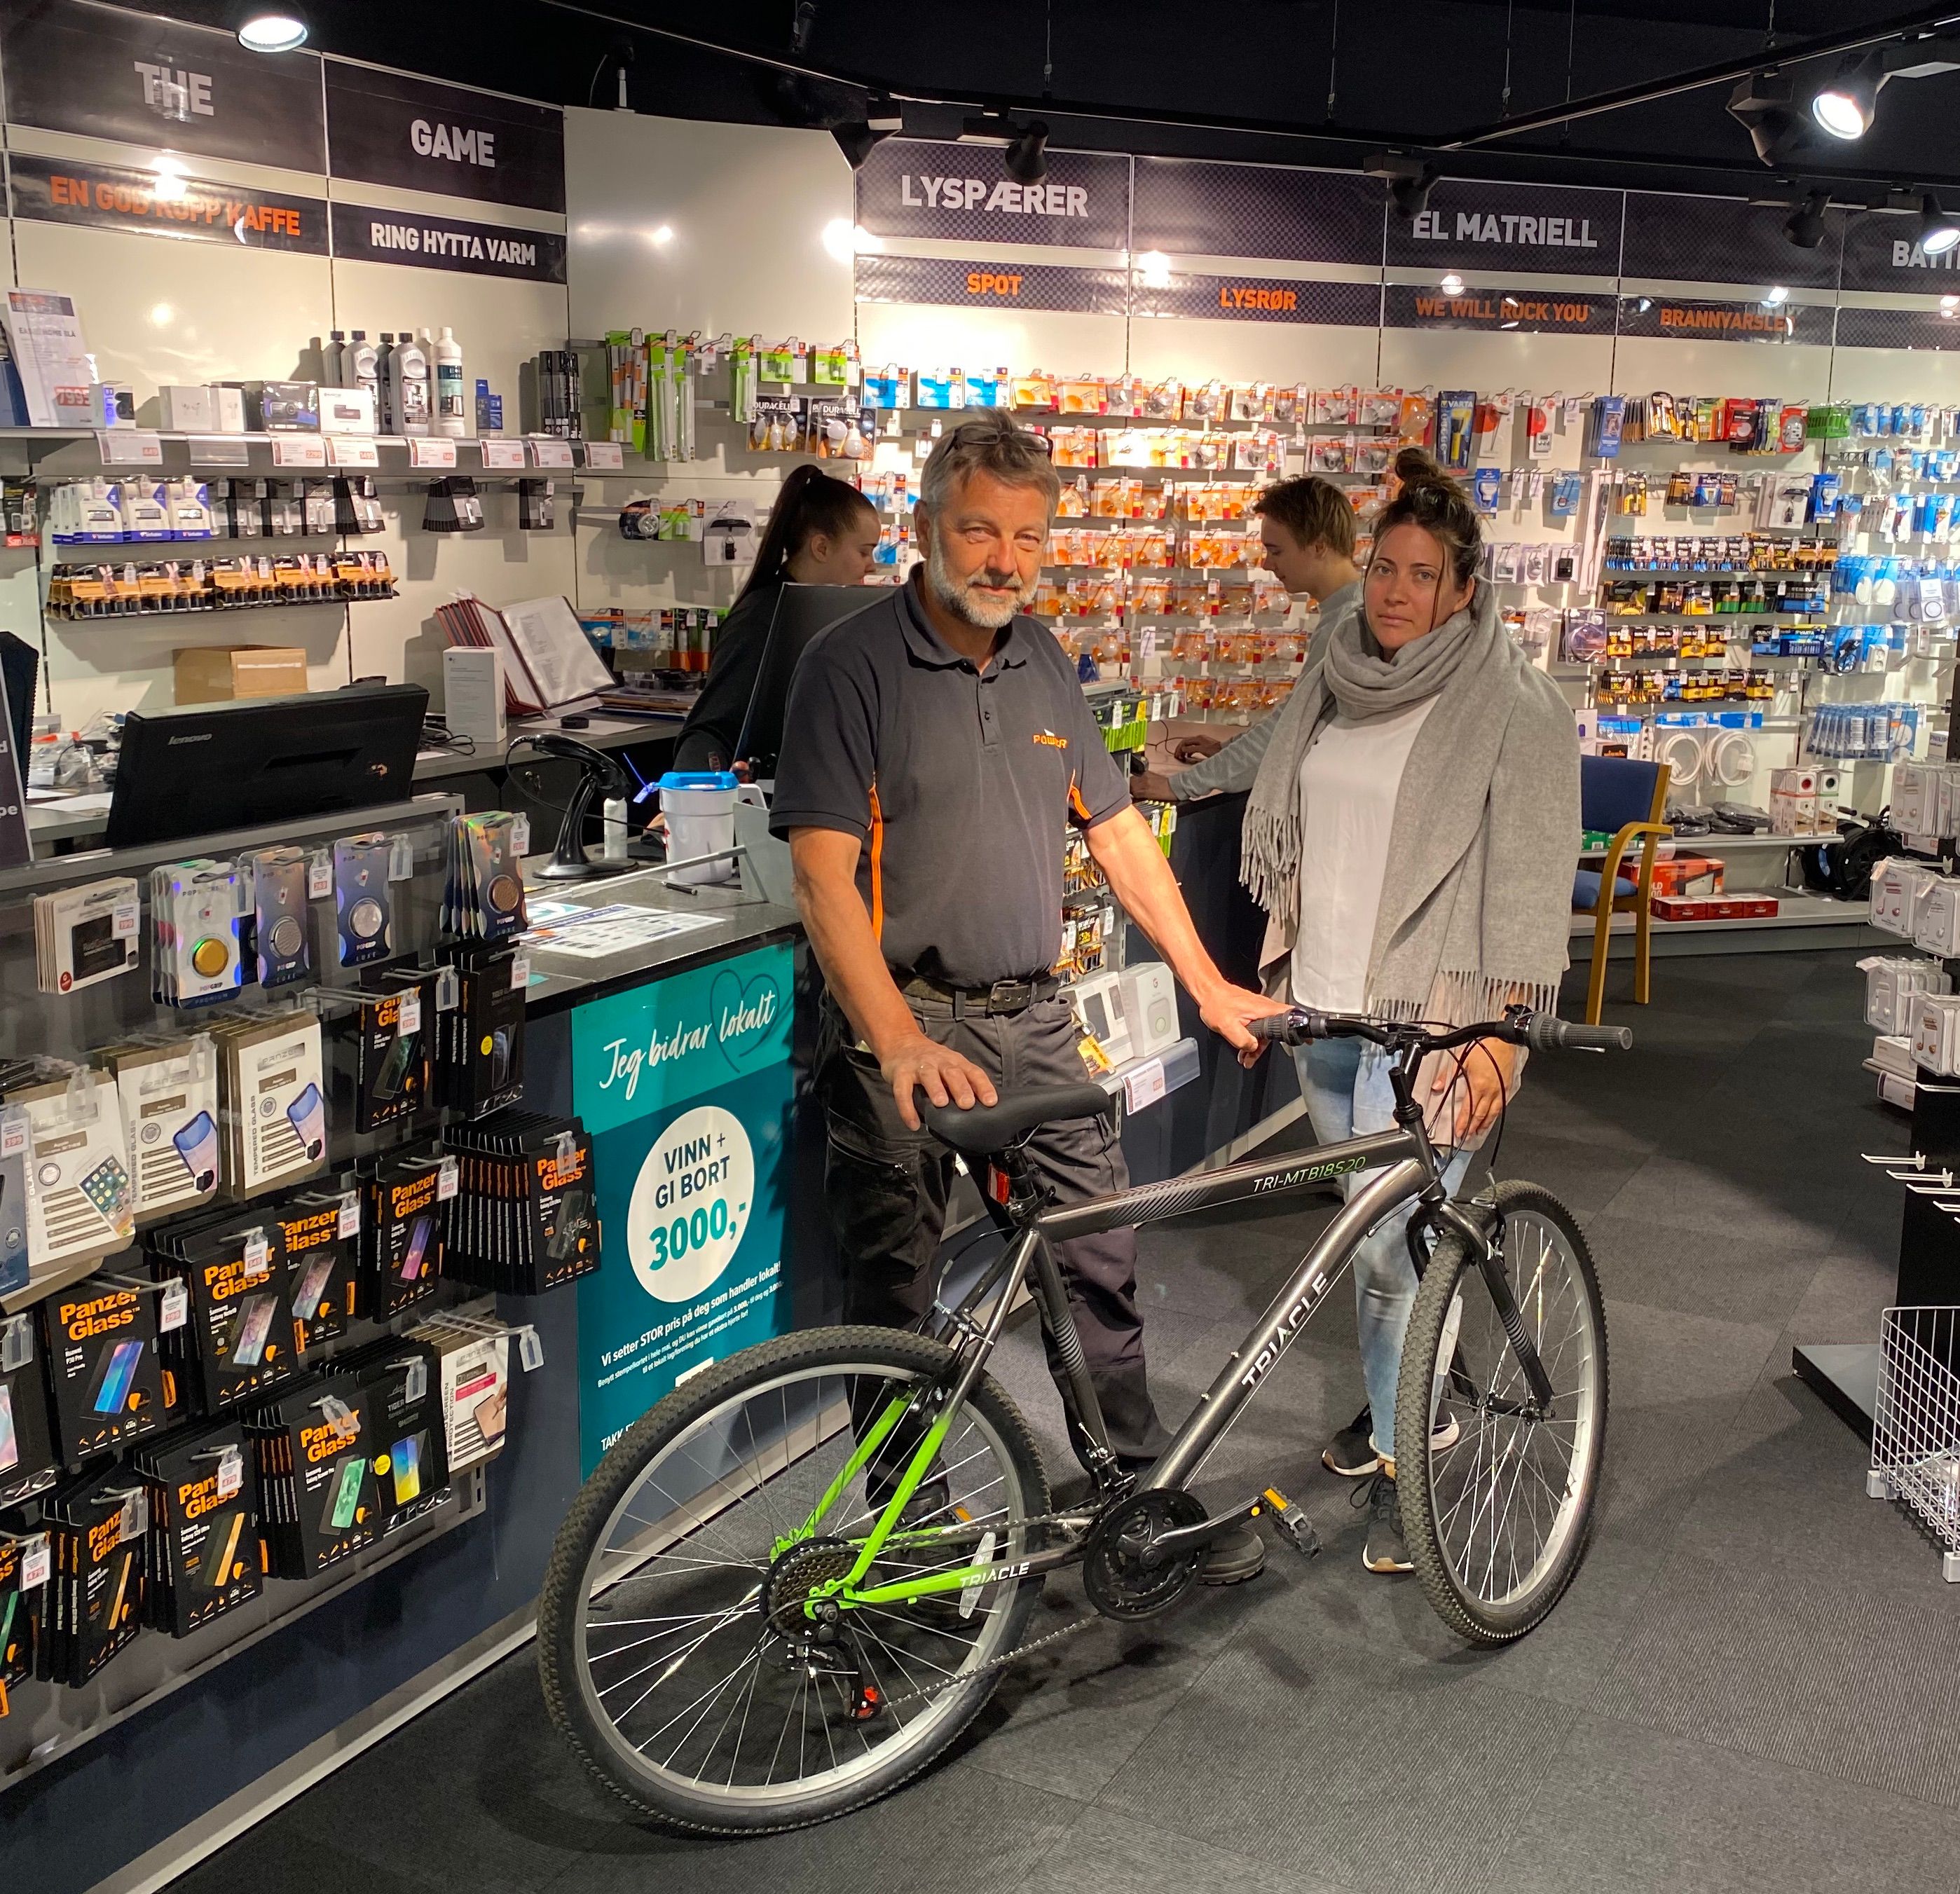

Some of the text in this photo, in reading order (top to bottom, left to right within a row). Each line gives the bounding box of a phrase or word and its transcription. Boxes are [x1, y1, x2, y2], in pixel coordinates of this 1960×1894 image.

[135, 62, 214, 116] THE
[411, 119, 495, 168] GAME
[50, 176, 89, 207] EN
[95, 183, 150, 215] GOD
[226, 202, 301, 235] KAFFE
[901, 174, 1088, 217] LYSPÆRER
[371, 222, 535, 266] RING HYTTA VARM
[1413, 211, 1597, 248] EL MATRIELL
[967, 273, 1022, 296] SPOT
[1221, 287, 1296, 311] LYSRØR
[1416, 297, 1589, 323] WE WILL ROCK YOU
[1033, 734, 1067, 749] POWER
[356, 952, 376, 961] LUXE
[378, 1009, 399, 1027] Gla
[599, 990, 775, 1101] Jeg bidrar lokalt
[664, 1133, 725, 1174] VINN +
[392, 1172, 437, 1205] Panzer
[655, 1155, 729, 1209] GI BORT
[1254, 1156, 1366, 1193] TRI-MTB18S20
[649, 1198, 746, 1271] 3000,-
[60, 1286, 140, 1325] Panzer
[165, 1308, 181, 1323] 299
[601, 1261, 781, 1366] Vi setter STOR pris på deg som handler lokalt!
[89, 1510, 121, 1549] Panz
[960, 1561, 1030, 1588] TRIACLE
